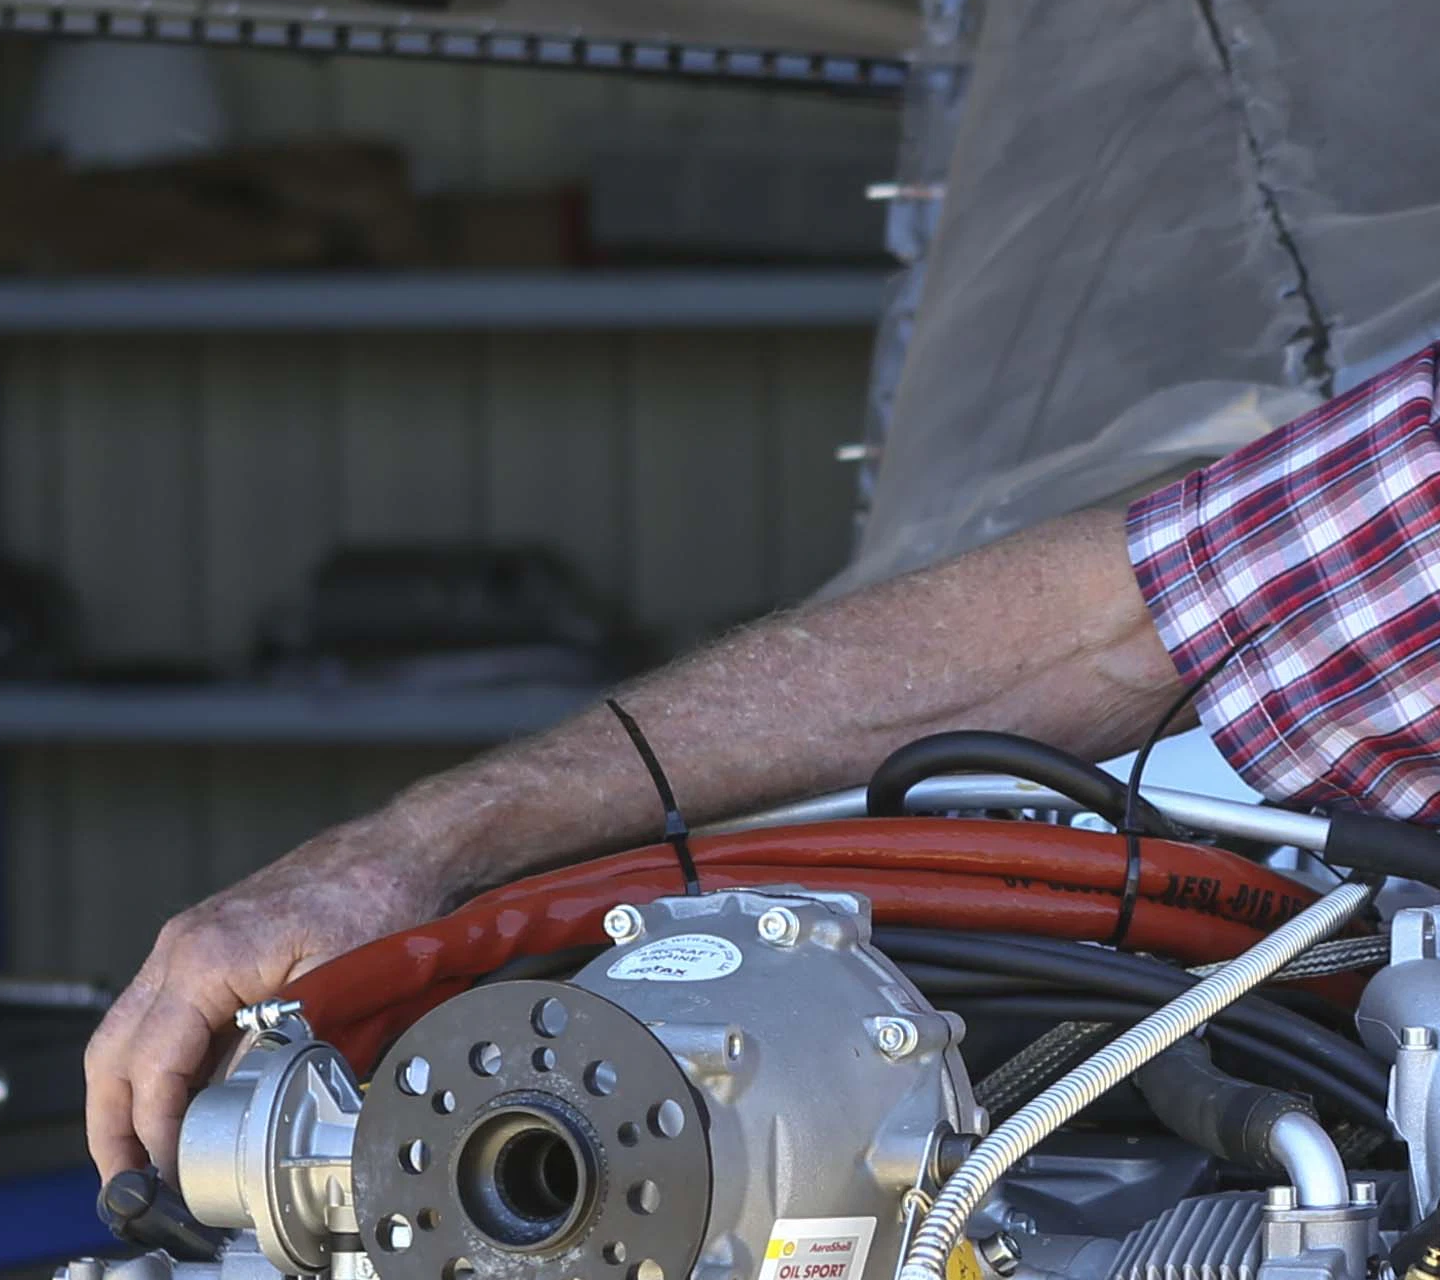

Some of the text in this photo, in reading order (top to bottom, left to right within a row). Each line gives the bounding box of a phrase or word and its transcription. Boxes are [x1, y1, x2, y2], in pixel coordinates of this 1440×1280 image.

[809, 1240, 853, 1254] AeroShell
[779, 1263, 847, 1279] OIL SPORT
